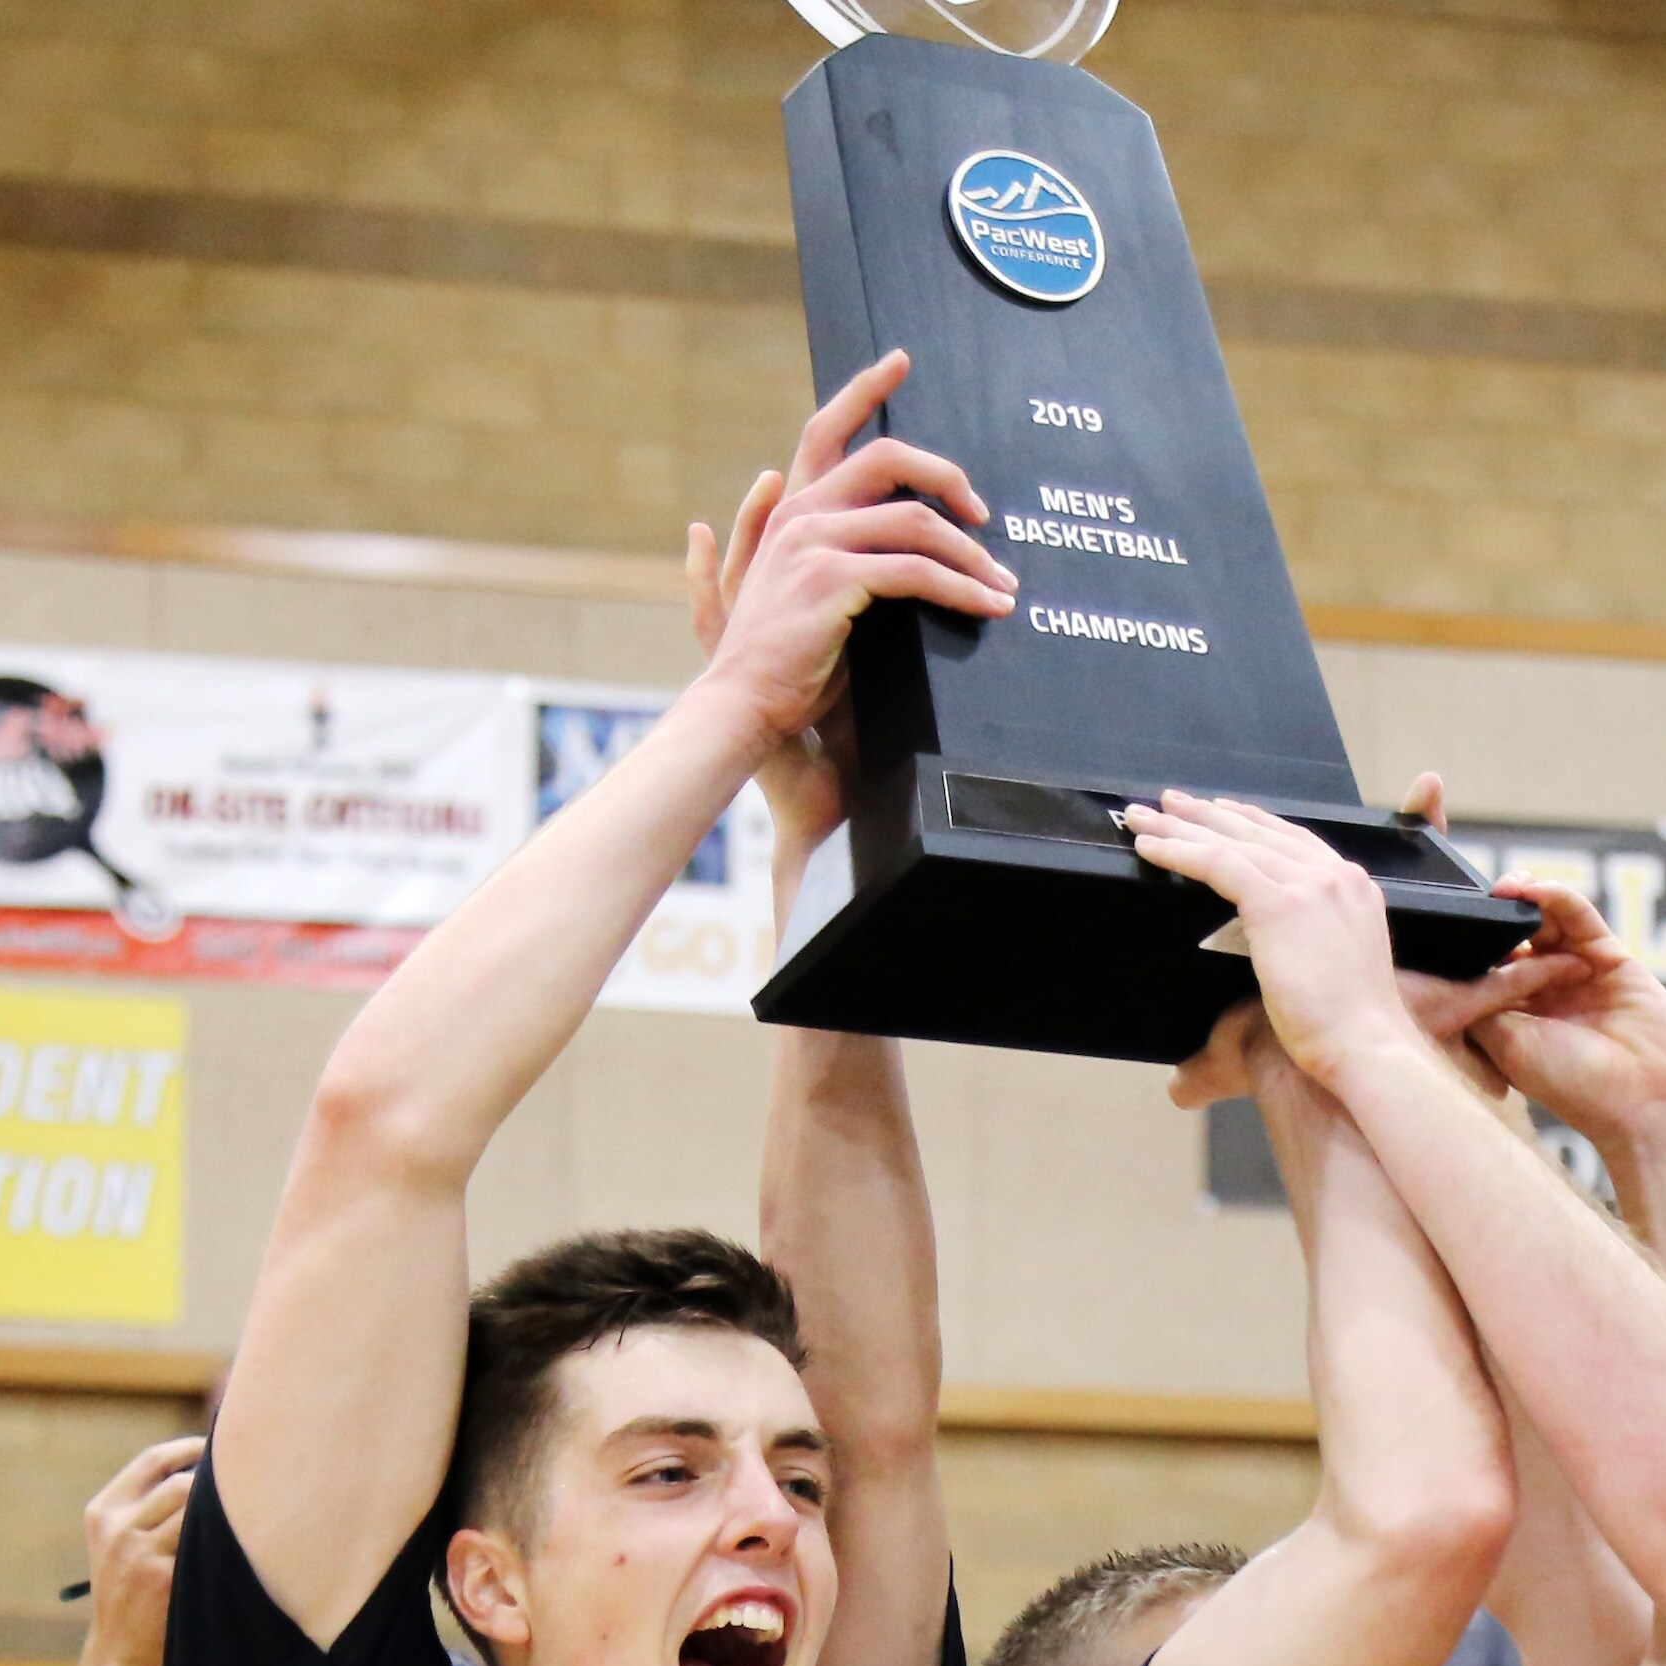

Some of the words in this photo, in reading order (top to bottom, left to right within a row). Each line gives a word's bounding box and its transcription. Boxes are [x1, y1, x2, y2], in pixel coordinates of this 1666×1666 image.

[970, 219, 1092, 258] PacWest
[990, 245, 1082, 270] CONFERENCE
[1028, 398, 1104, 433] 2019
[1038, 485, 1137, 525] MEN'S
[1003, 515, 1189, 565] BASKETBALL
[1029, 606, 1210, 654] CHAMPIONS
